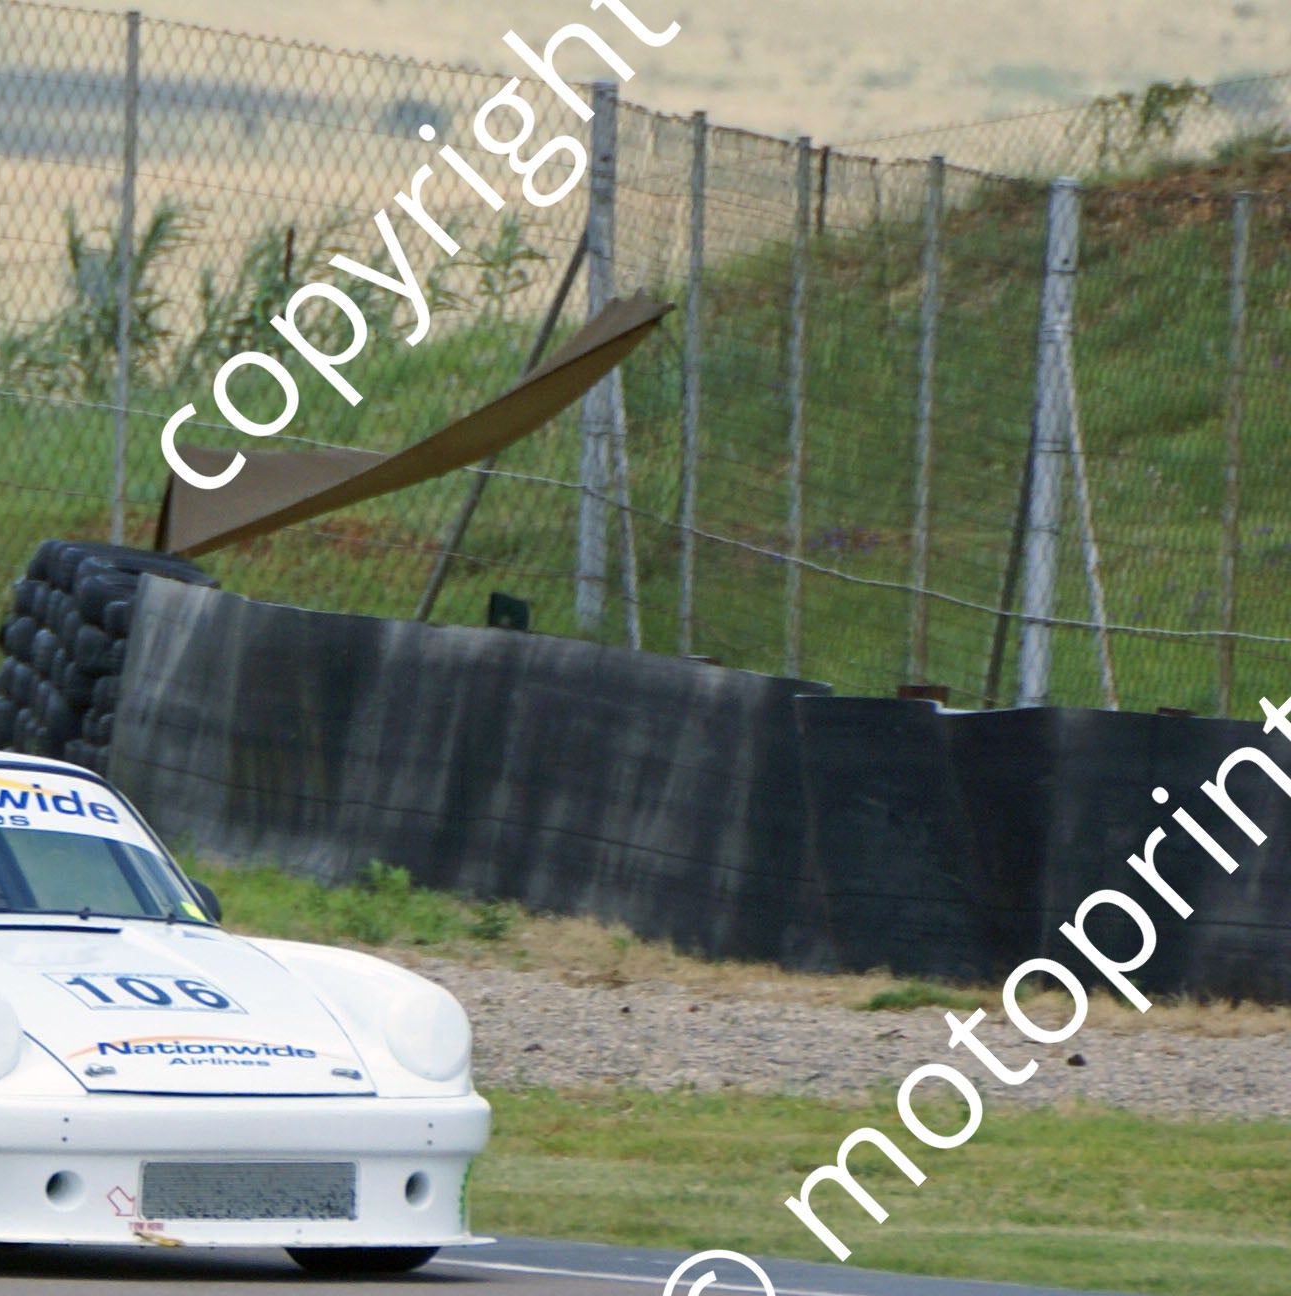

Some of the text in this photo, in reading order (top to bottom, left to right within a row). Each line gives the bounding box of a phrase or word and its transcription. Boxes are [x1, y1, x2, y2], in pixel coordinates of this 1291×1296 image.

[65, 976, 230, 1010] 106
[96, 1040, 316, 1059] Nationwide
[169, 1055, 271, 1068] Airlines
